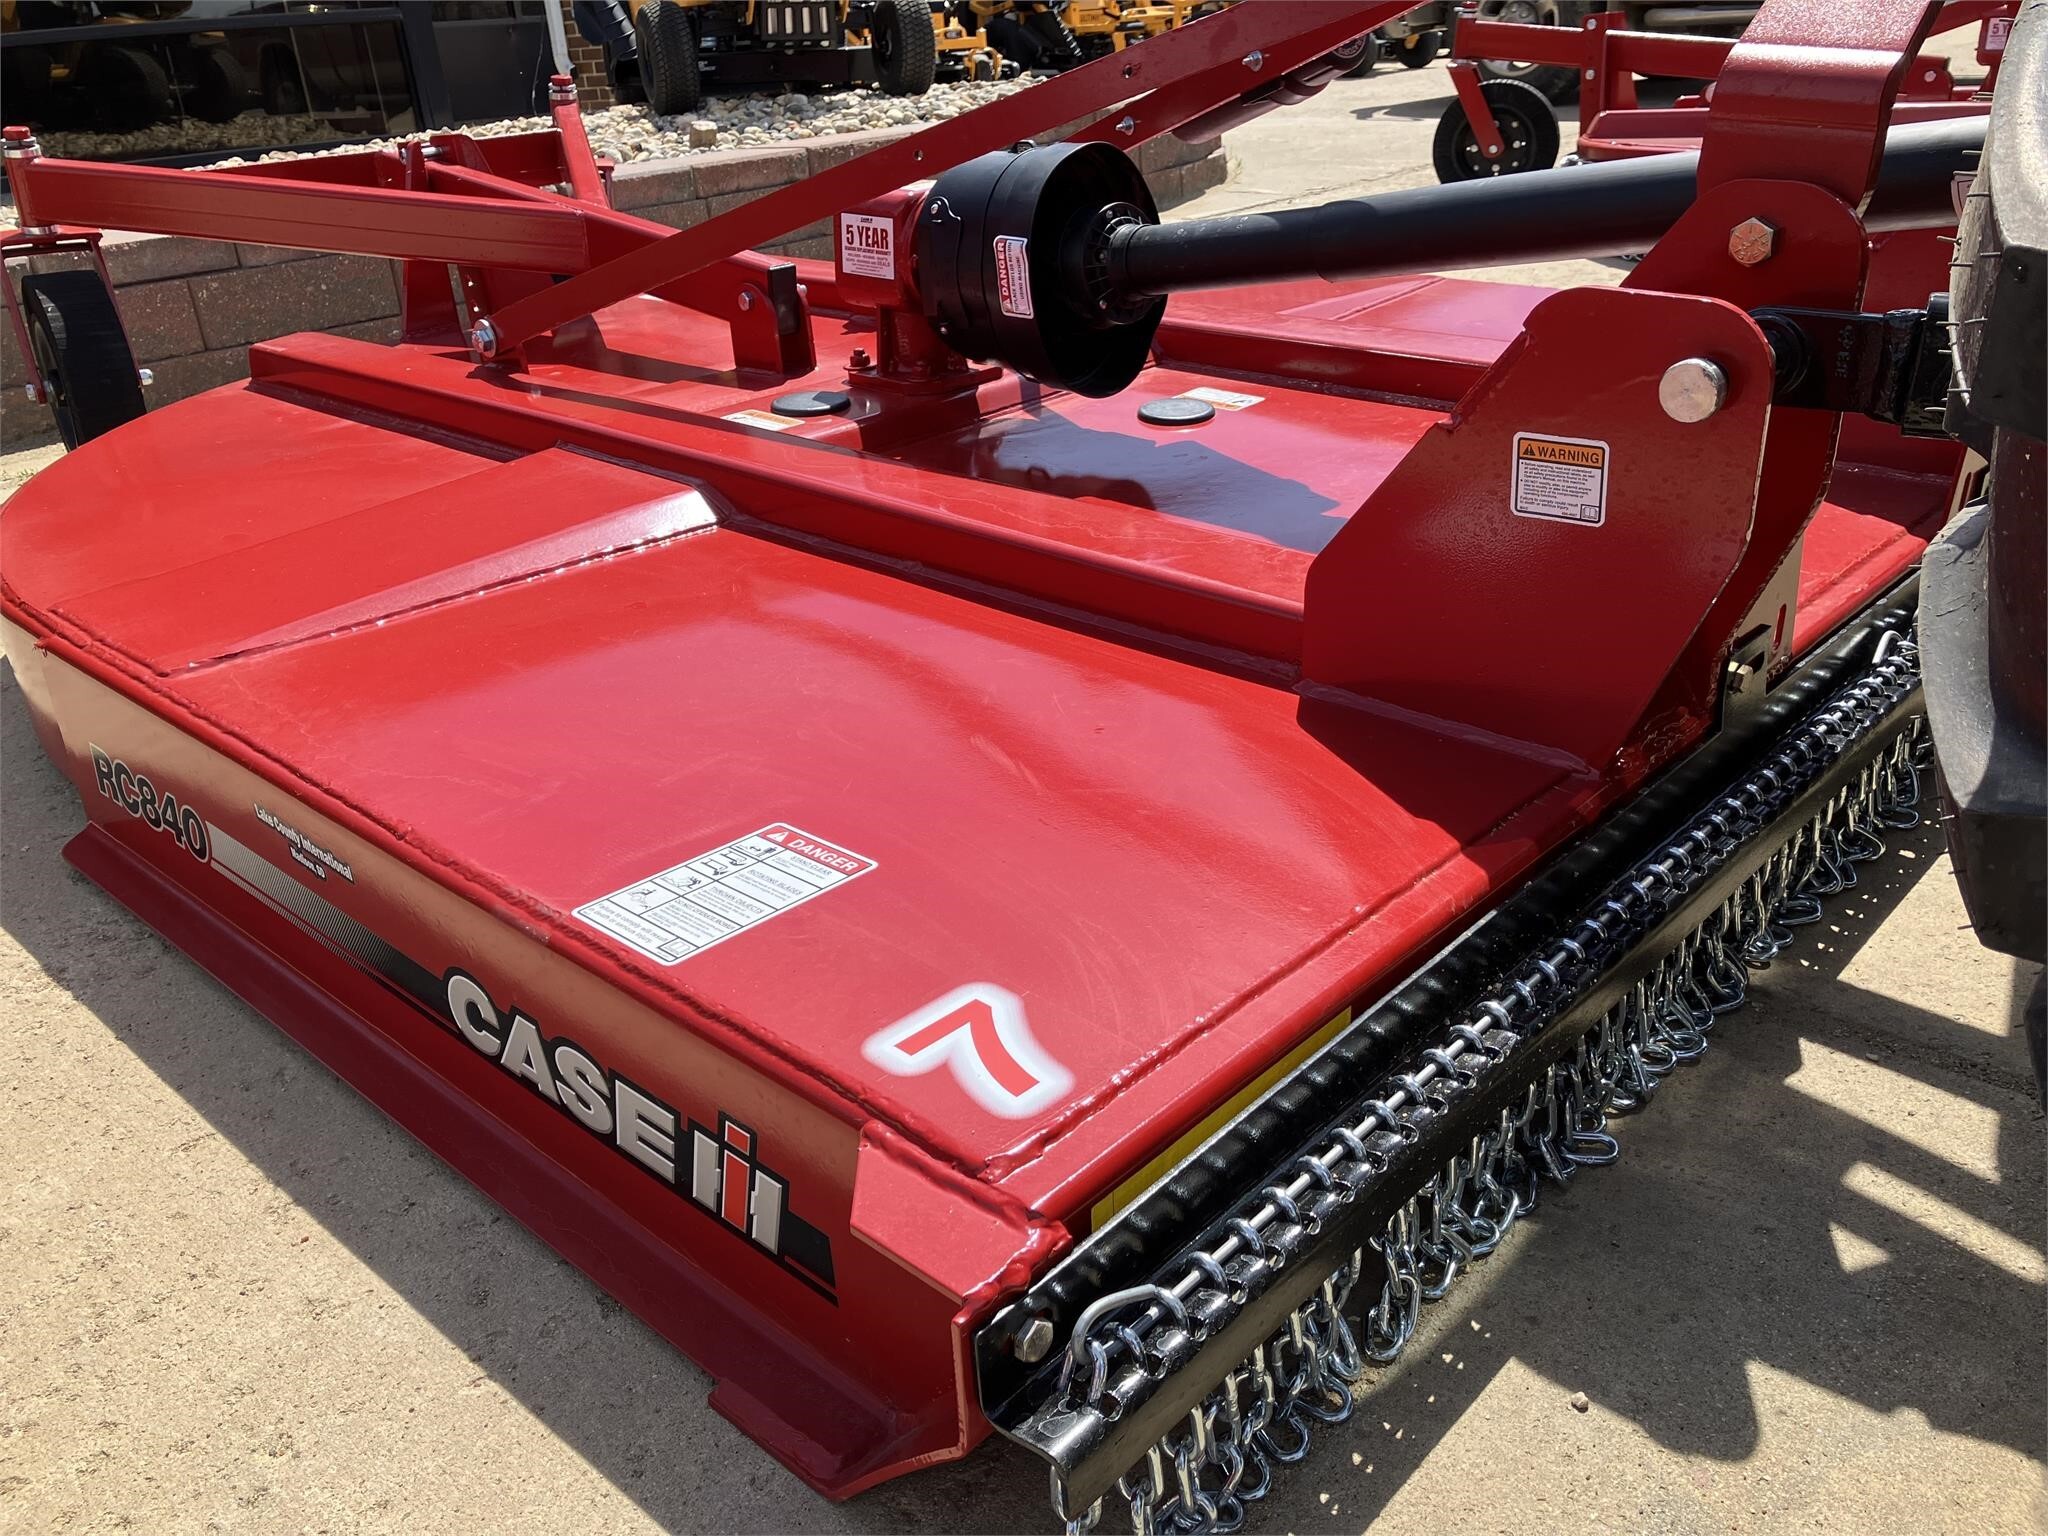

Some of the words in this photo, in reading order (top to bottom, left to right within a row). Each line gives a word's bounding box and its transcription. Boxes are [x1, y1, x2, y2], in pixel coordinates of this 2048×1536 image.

[1992, 23, 1999, 34] 5
[846, 224, 854, 245] 5
[857, 225, 889, 250] YEAR
[997, 241, 1010, 297] DANGER
[1537, 445, 1600, 464] WARNING
[89, 742, 209, 863] RC840
[254, 803, 274, 827] Lake
[300, 833, 353, 881] International
[787, 838, 860, 872] DANGER
[447, 974, 675, 1184] CASE
